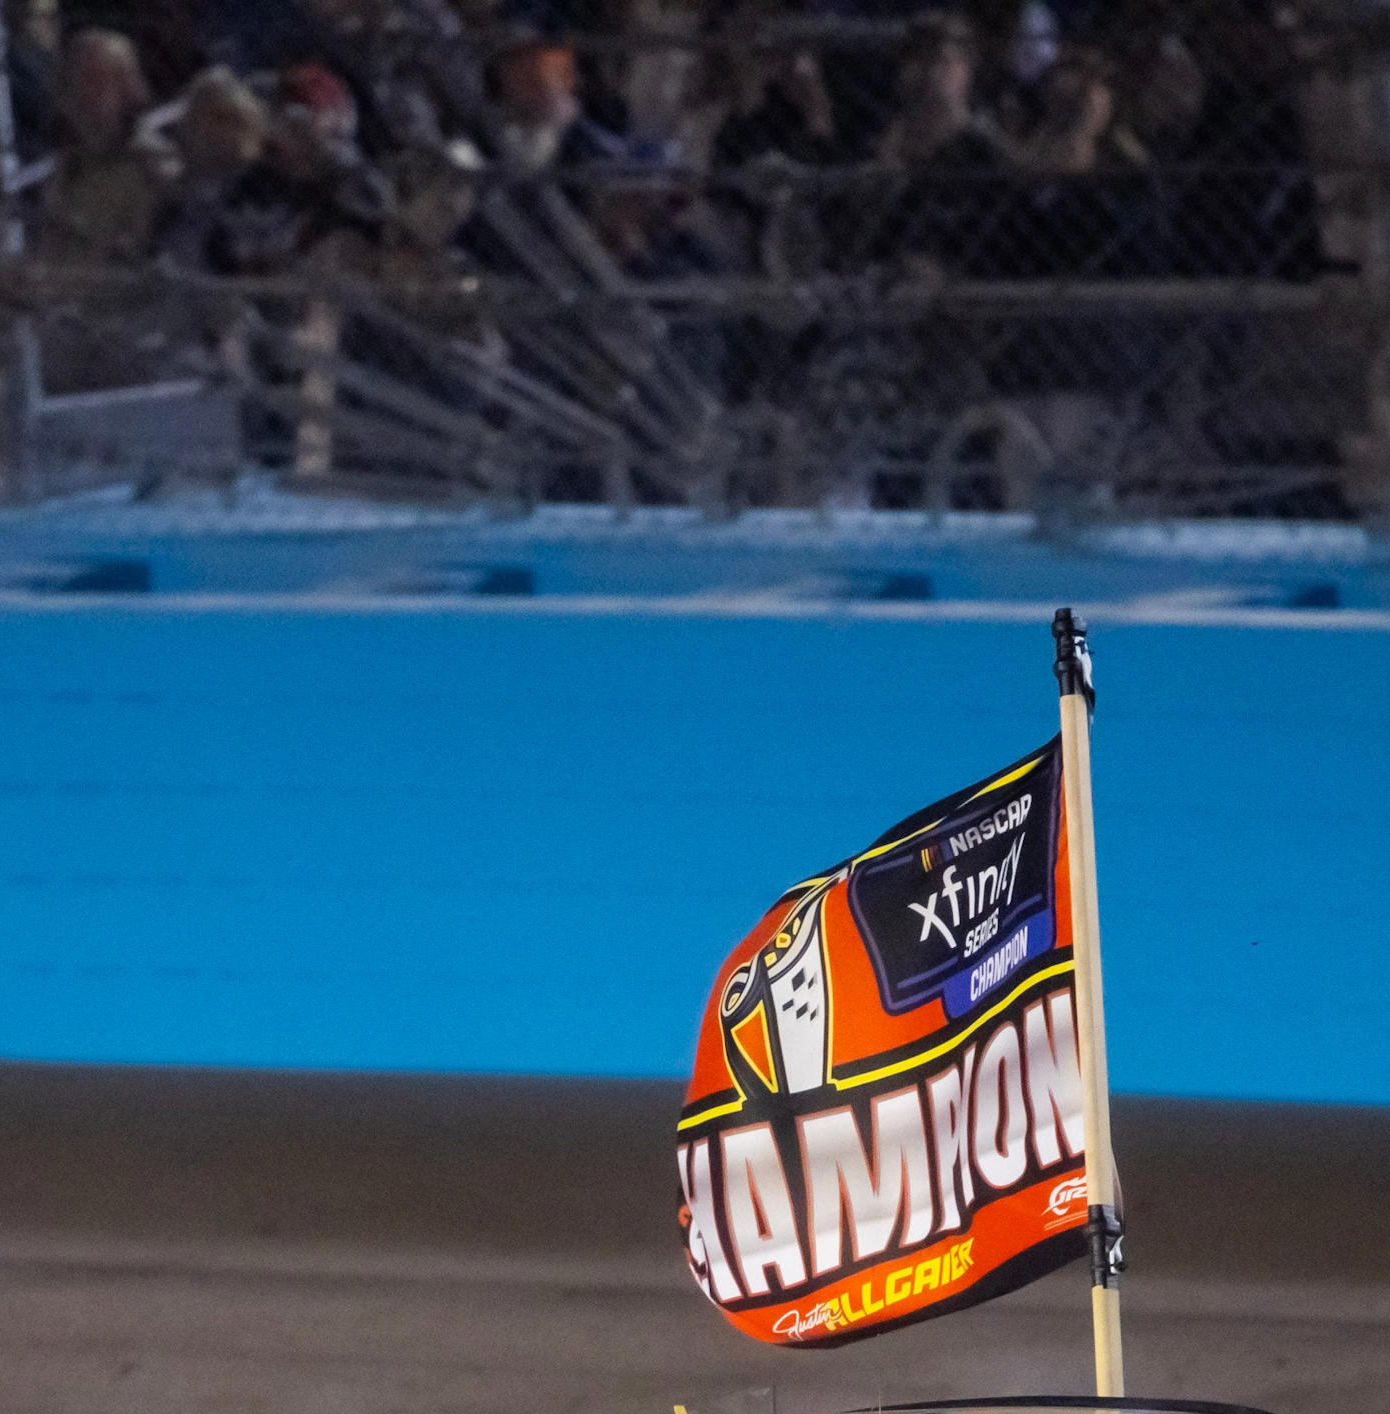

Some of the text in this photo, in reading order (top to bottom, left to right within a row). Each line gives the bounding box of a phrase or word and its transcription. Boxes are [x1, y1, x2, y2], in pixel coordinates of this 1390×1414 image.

[949, 793, 1033, 857] NASCAR
[964, 908, 1000, 958] SERIES
[970, 925, 1029, 1002] CHAMPION
[677, 993, 1086, 1302] HAMPION
[772, 1237, 974, 1341] Justin ALLGAIER
